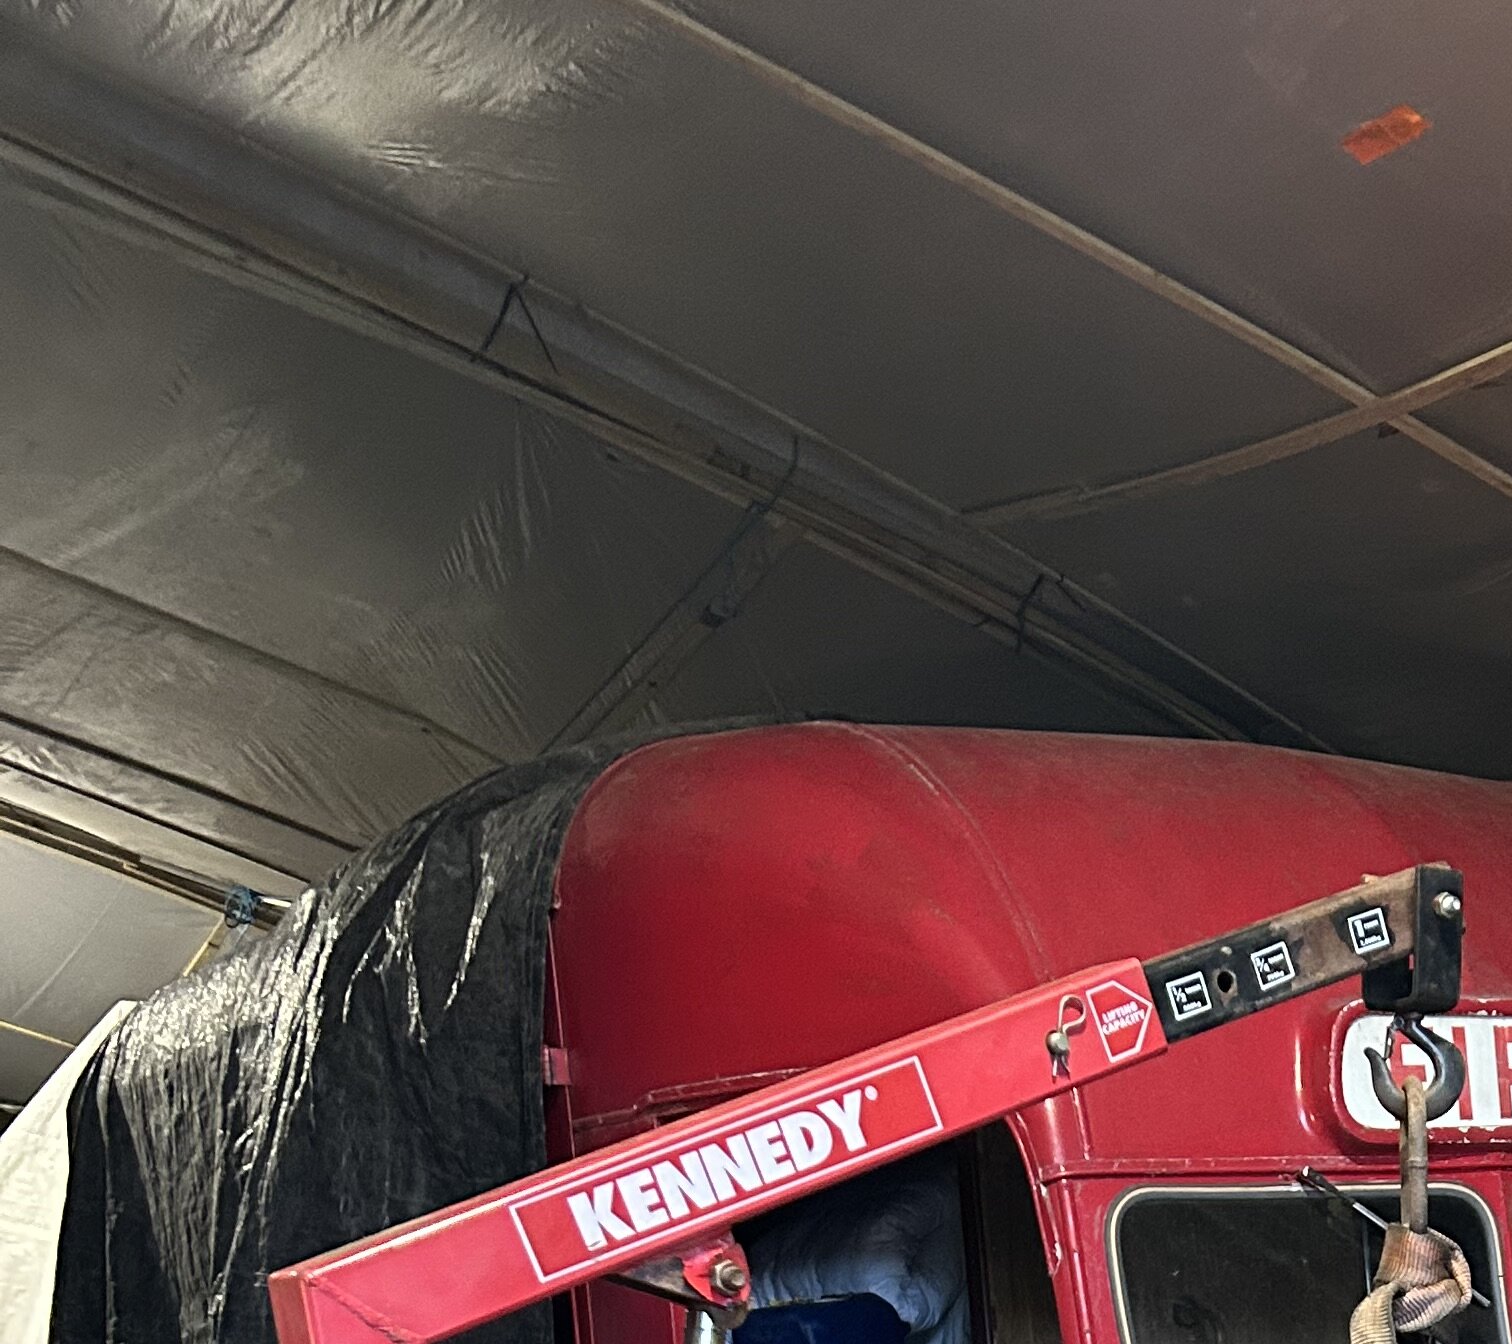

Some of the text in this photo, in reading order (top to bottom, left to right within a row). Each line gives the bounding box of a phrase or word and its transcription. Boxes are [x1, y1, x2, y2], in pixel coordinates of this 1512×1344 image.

[1101, 1000, 1138, 1024] LIFTING
[1102, 1008, 1145, 1036] CAPACITY
[566, 1088, 867, 1251] KENNEDY
